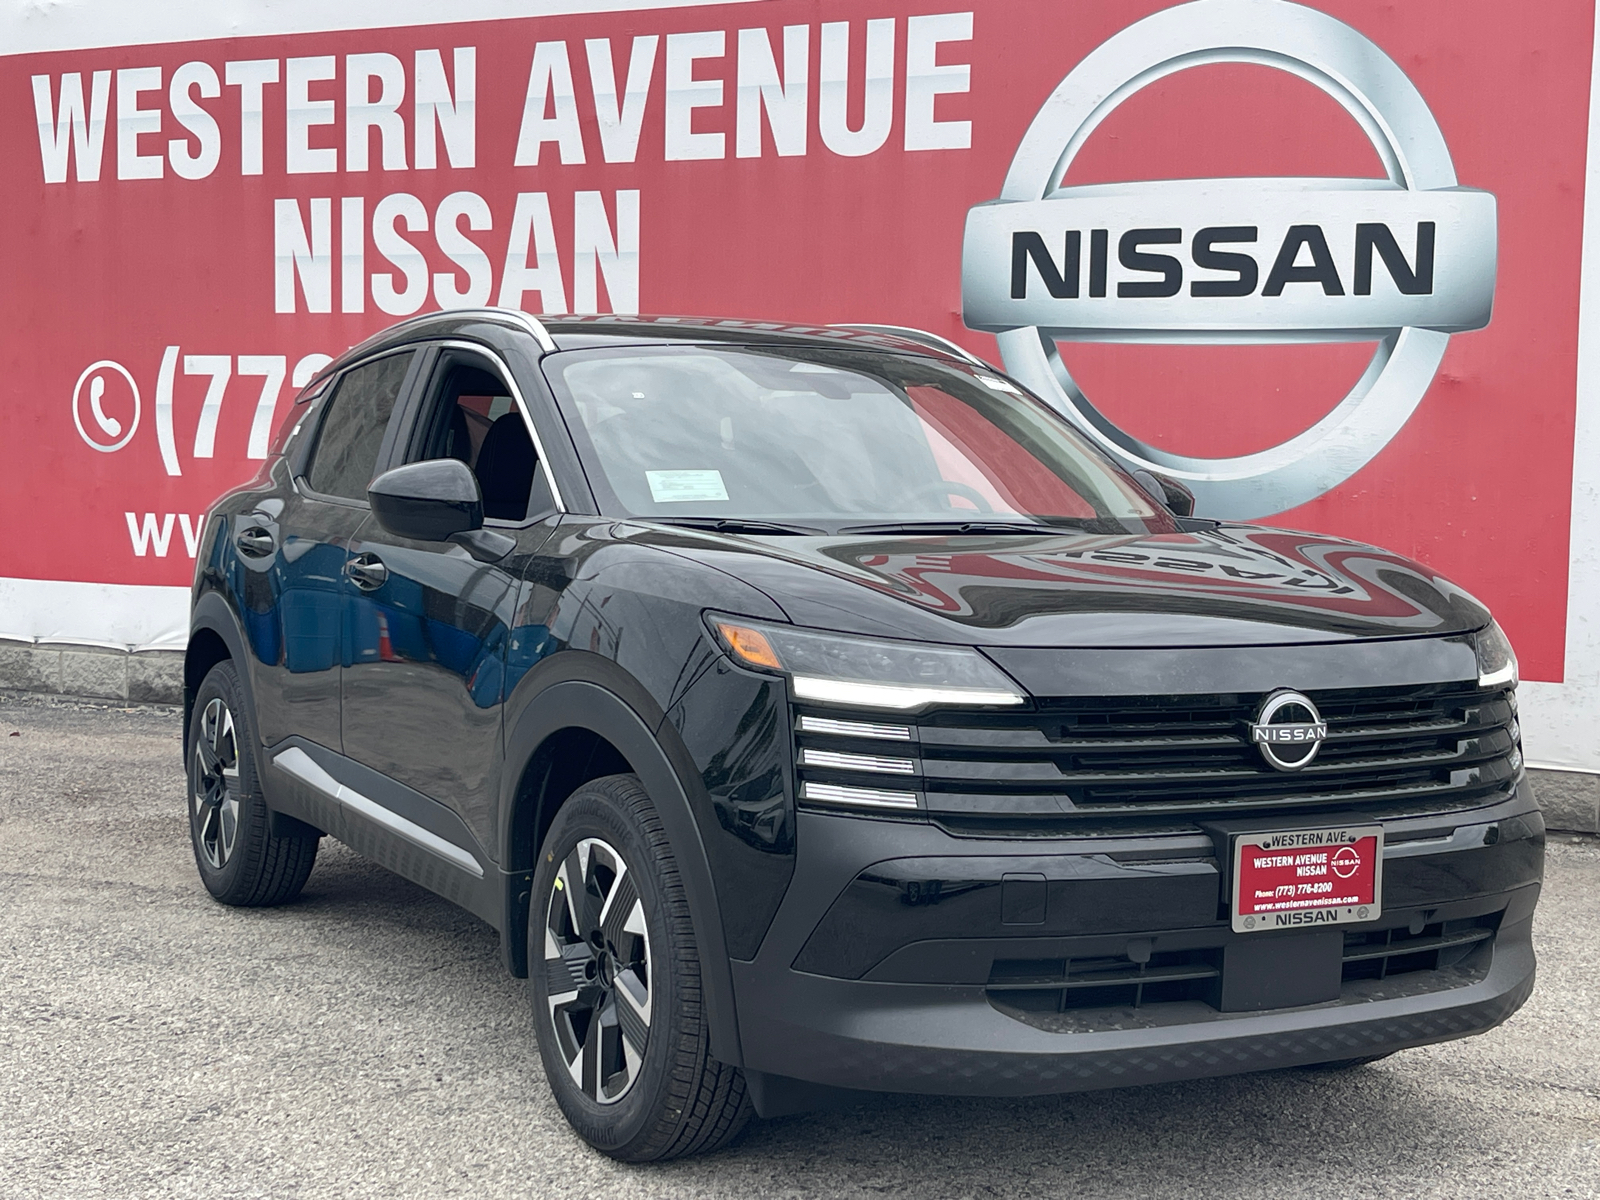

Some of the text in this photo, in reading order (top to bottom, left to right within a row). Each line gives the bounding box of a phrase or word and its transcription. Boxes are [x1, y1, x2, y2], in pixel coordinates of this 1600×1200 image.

[31, 12, 974, 184] WESTERN AVENUE
[273, 189, 641, 316] NISSAN
[1011, 221, 1436, 299] NISSAN
[155, 346, 335, 476] (77
[1255, 726, 1326, 741] NISSAN
[1271, 834, 1323, 847] WESTERN
[1253, 852, 1328, 869] WESTERN AVENUE
[1330, 859, 1361, 867] NISSAN
[1296, 865, 1328, 877] NISSAN
[1275, 885, 1296, 899] (773)
[1297, 882, 1333, 895] 776-8200
[1253, 896, 1359, 912] www.westernavenissan.com
[1275, 909, 1338, 926] NISSAN
